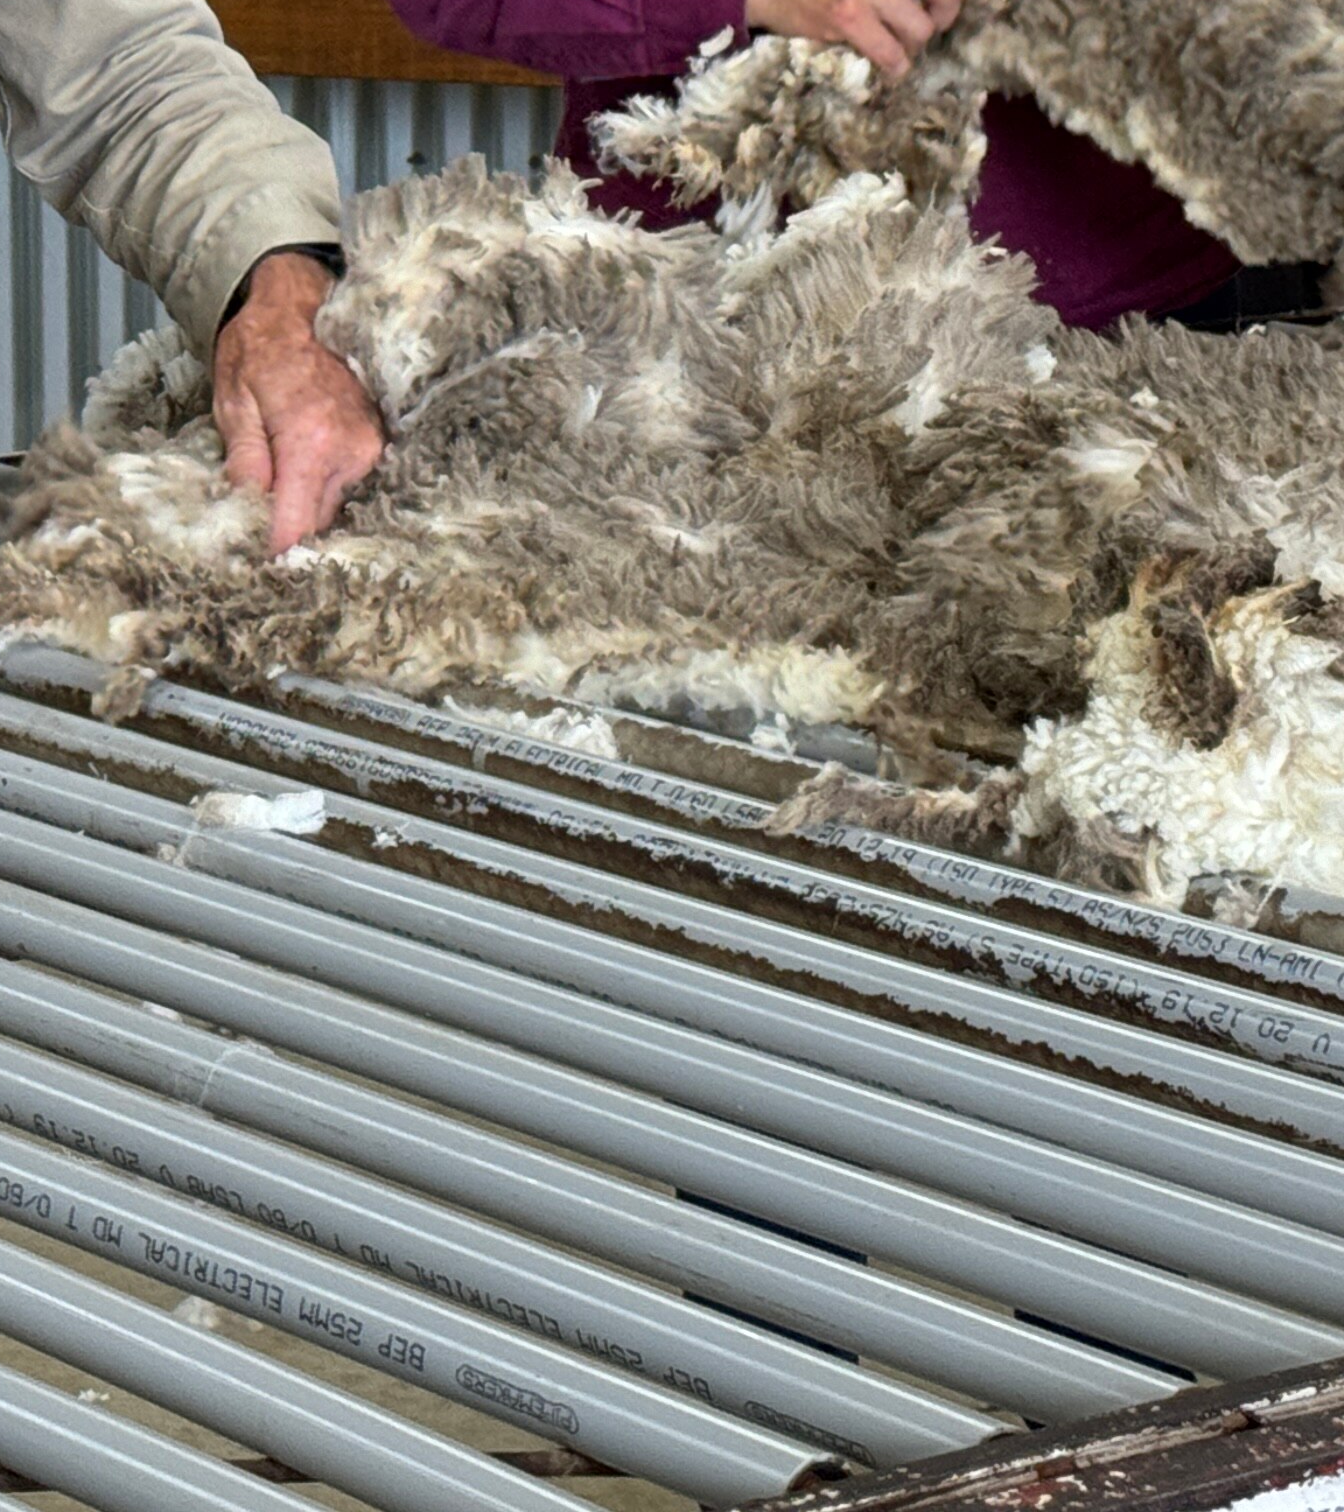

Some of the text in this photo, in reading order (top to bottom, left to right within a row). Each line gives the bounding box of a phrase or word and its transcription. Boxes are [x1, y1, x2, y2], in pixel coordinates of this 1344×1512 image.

[62, 1205, 86, 1231] T
[90, 1215, 124, 1248] MD
[131, 1231, 287, 1314] ELECTRICAL
[295, 1297, 366, 1346] 25MM
[377, 1331, 427, 1371] BEP
